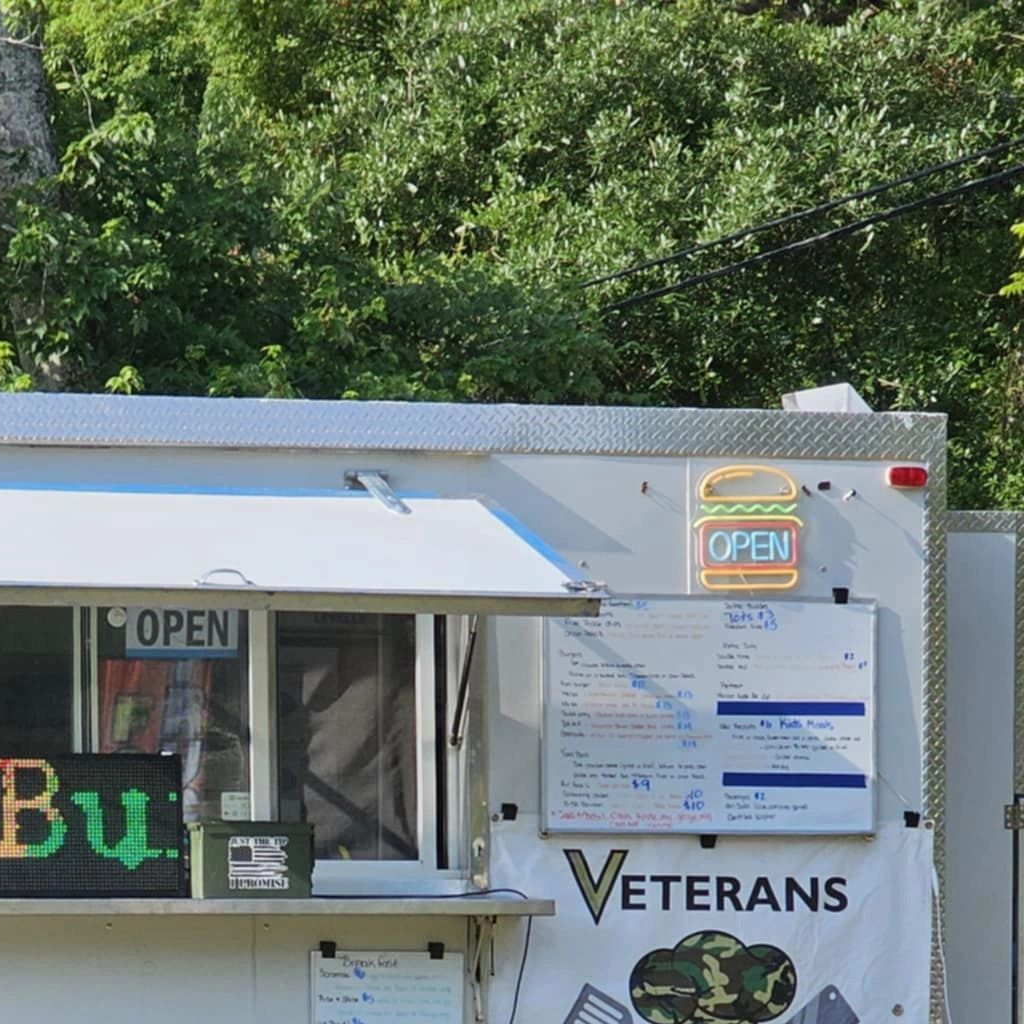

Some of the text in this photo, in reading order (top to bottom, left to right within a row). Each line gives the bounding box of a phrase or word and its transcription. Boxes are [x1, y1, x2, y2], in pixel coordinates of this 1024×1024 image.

[708, 530, 789, 561] OPEN
[136, 609, 229, 647] OPEN
[632, 779, 651, 792] $9
[562, 849, 849, 926] VETERANS
